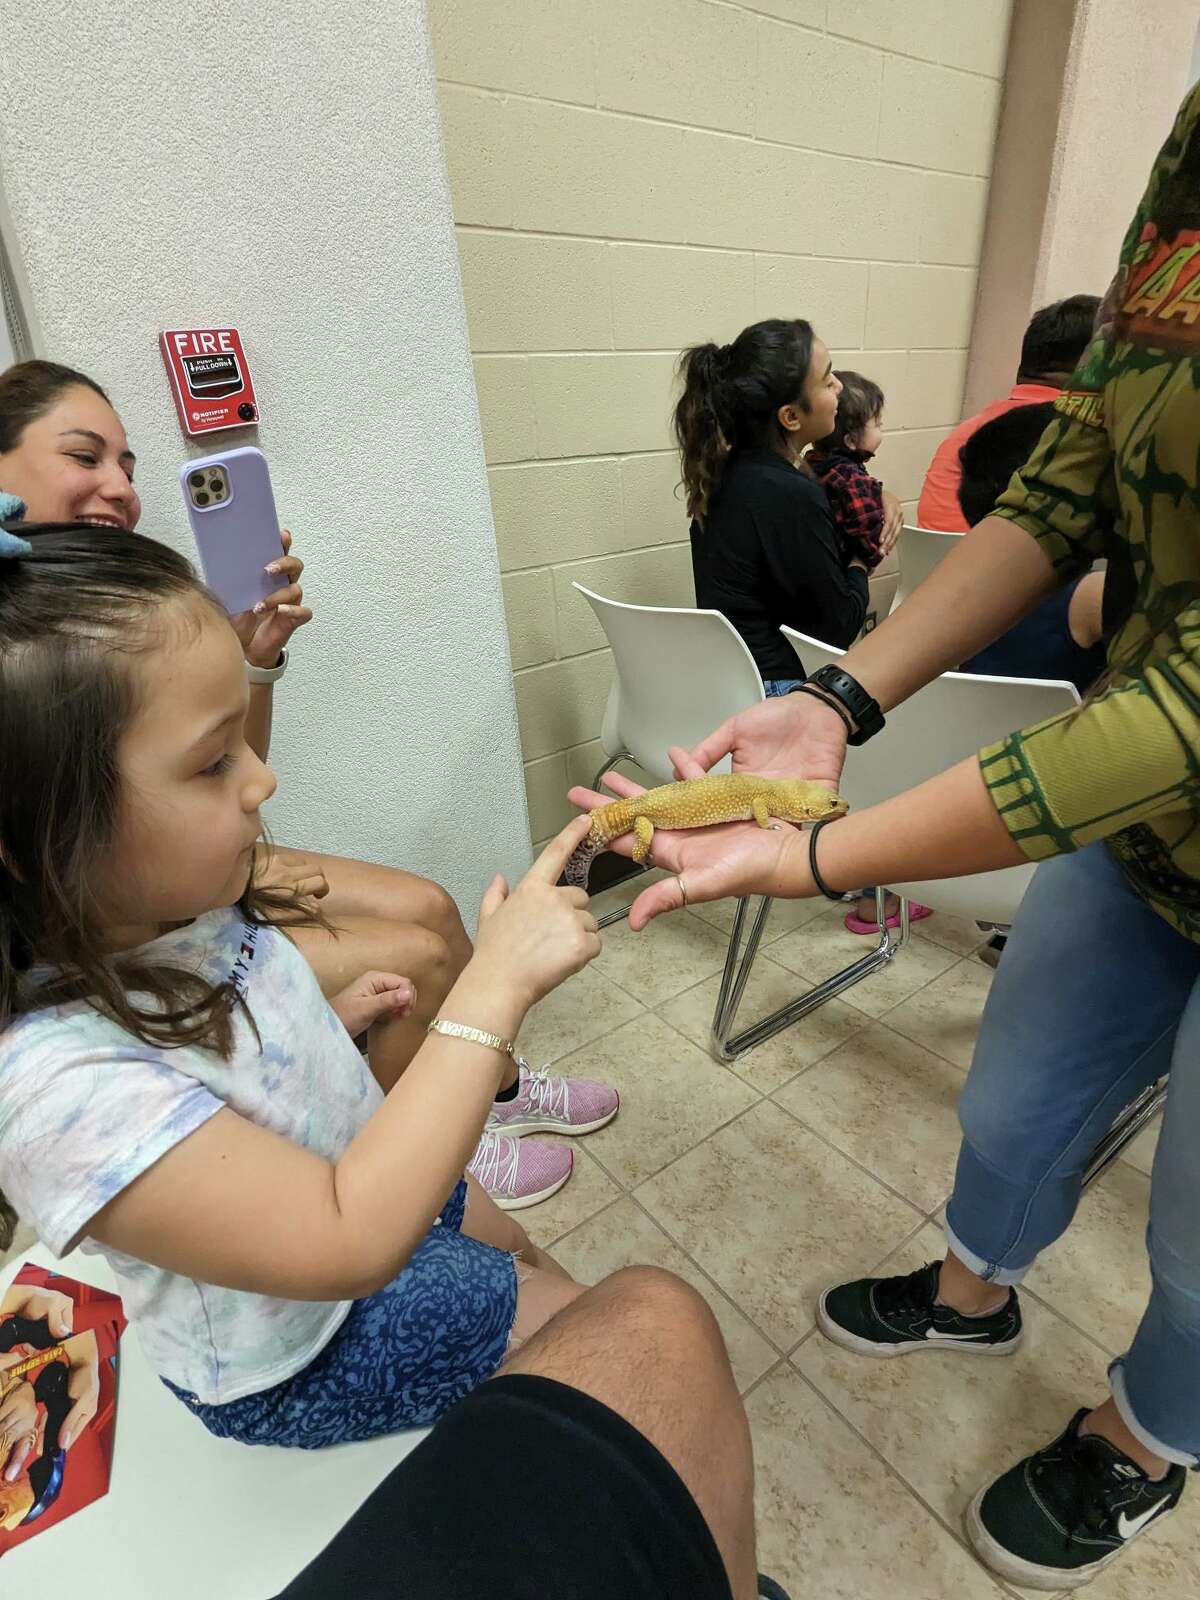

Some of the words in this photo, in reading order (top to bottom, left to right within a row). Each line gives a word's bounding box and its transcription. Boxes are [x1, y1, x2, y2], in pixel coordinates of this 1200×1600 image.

[174, 332, 234, 355] FIRE
[194, 364, 211, 372] PULL
[210, 361, 229, 369] DOWN
[200, 409, 229, 417] NOTIFIER
